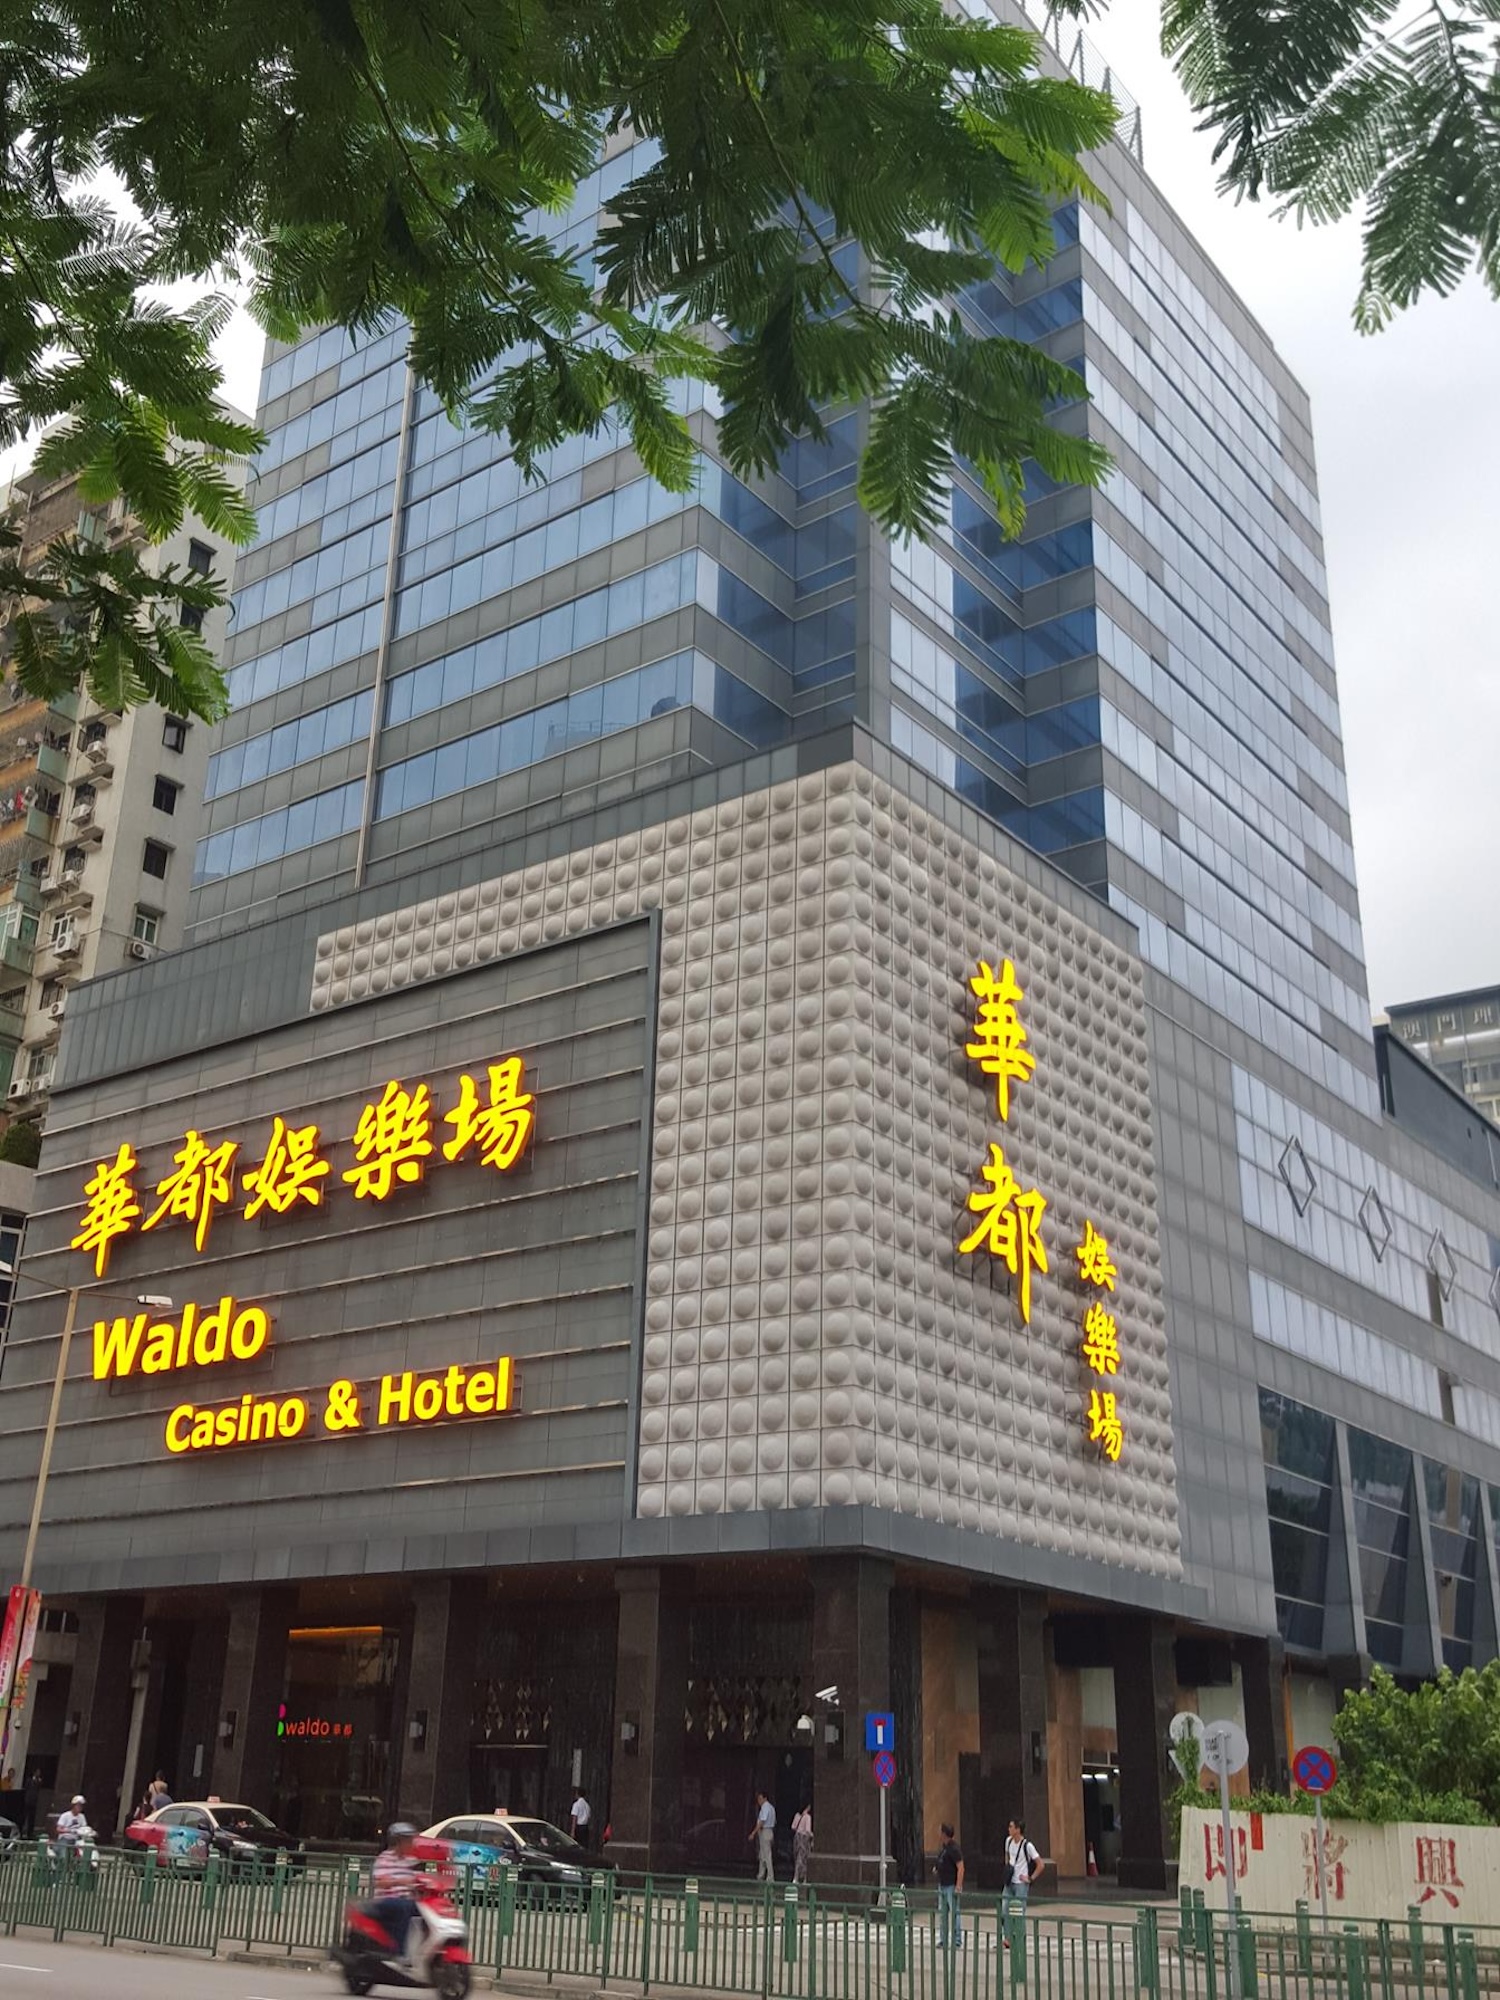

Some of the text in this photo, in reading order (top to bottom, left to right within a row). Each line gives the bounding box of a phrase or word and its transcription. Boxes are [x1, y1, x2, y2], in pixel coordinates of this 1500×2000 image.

[70, 1056, 534, 1278] 華都娛樂場
[958, 957, 1050, 1324] 華都
[92, 1296, 269, 1380] Waldo
[164, 1356, 513, 1453] Casino & Hotel
[1075, 1218, 1125, 1462] 娛樂場
[285, 1717, 330, 1736] waldo
